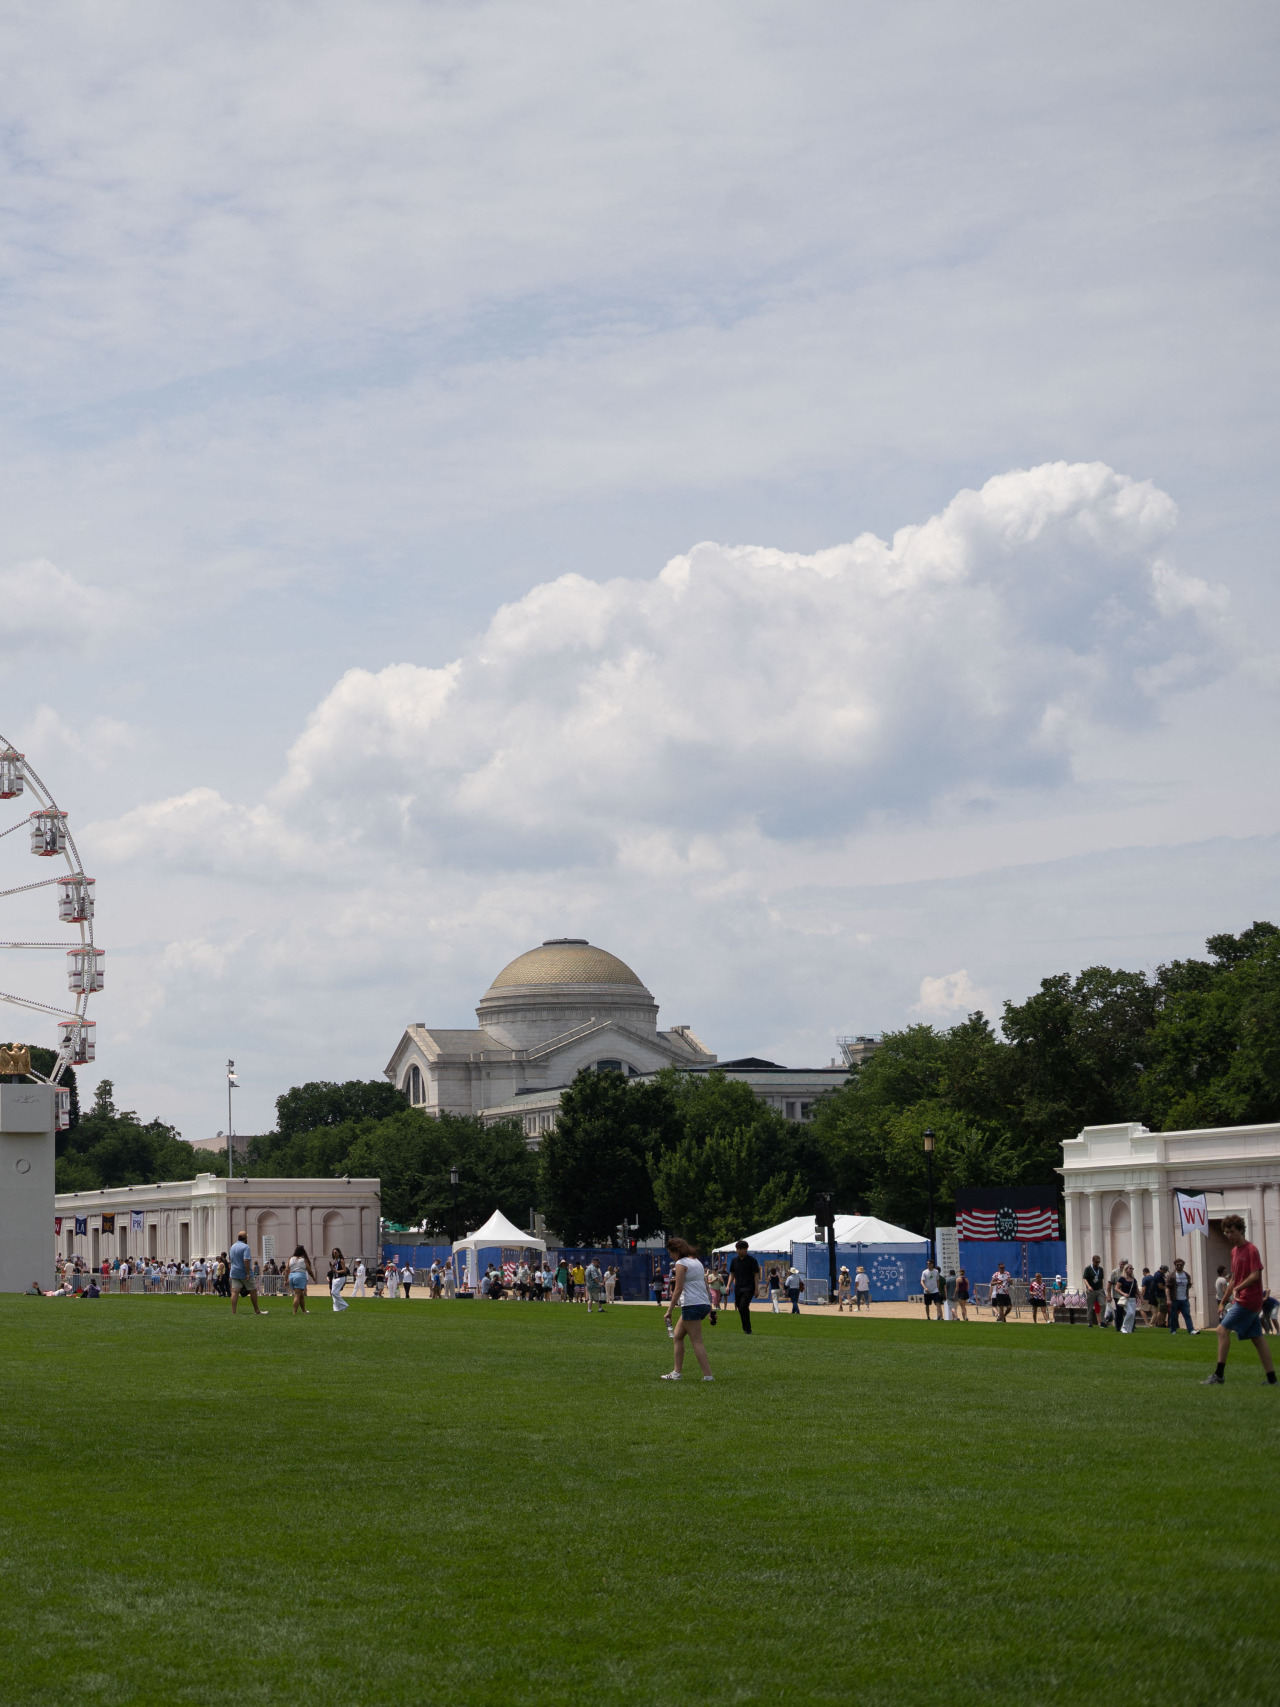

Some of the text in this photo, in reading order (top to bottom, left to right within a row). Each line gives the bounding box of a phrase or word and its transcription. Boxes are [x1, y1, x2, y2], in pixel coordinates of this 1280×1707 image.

[1182, 1207, 1205, 1226] WV
[77, 1223, 85, 1232] LA
[132, 1220, 142, 1229] PR
[1000, 1221, 1014, 1232] 250
[878, 1270, 898, 1281] 250
